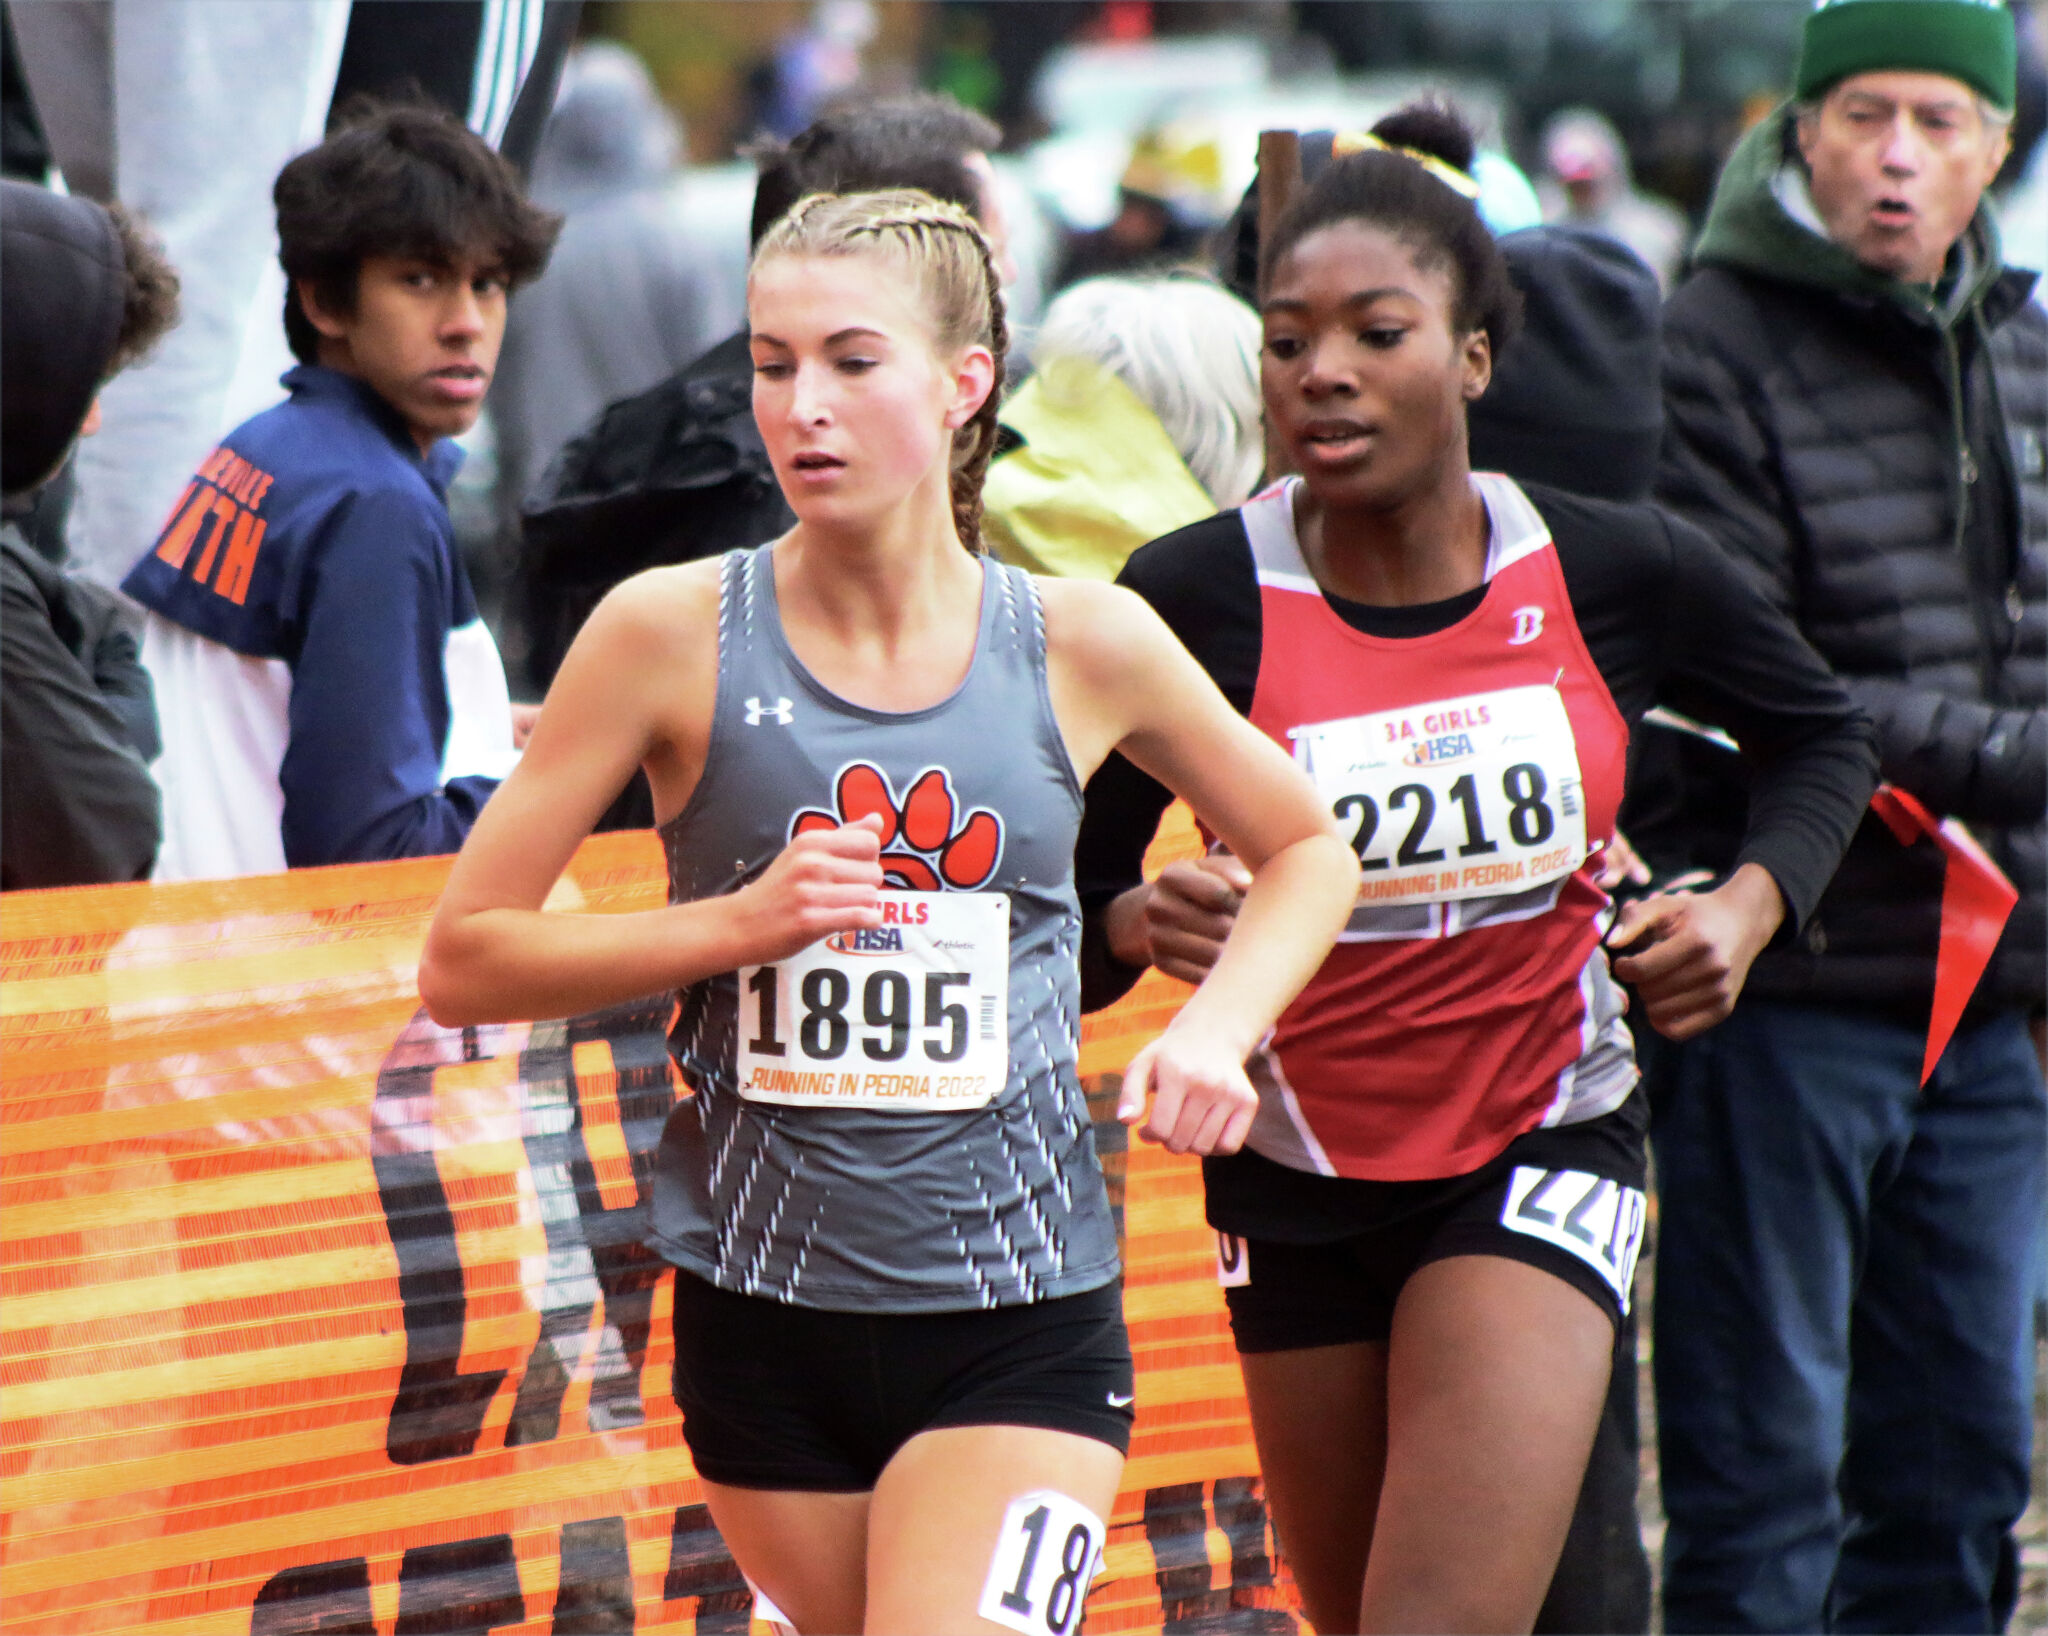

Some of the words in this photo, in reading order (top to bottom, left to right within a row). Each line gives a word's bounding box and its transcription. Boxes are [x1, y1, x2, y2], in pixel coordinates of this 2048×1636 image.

[1385, 720, 1415, 742] 3A
[1424, 705, 1490, 734] GIRLS
[1332, 763, 1555, 872] 2218
[1359, 873, 1436, 898] RUNNING
[1440, 871, 1458, 891] IN
[1463, 861, 1525, 887] PEORIA
[1531, 846, 1571, 877] 2022
[877, 901, 928, 925] RLS
[748, 966, 971, 1063] 1895
[750, 1067, 835, 1096] RUNNING
[838, 1073, 860, 1096] IN
[862, 1074, 930, 1098] PEORIA
[936, 1075, 986, 1098] 2022
[1000, 1505, 1094, 1636] 18
